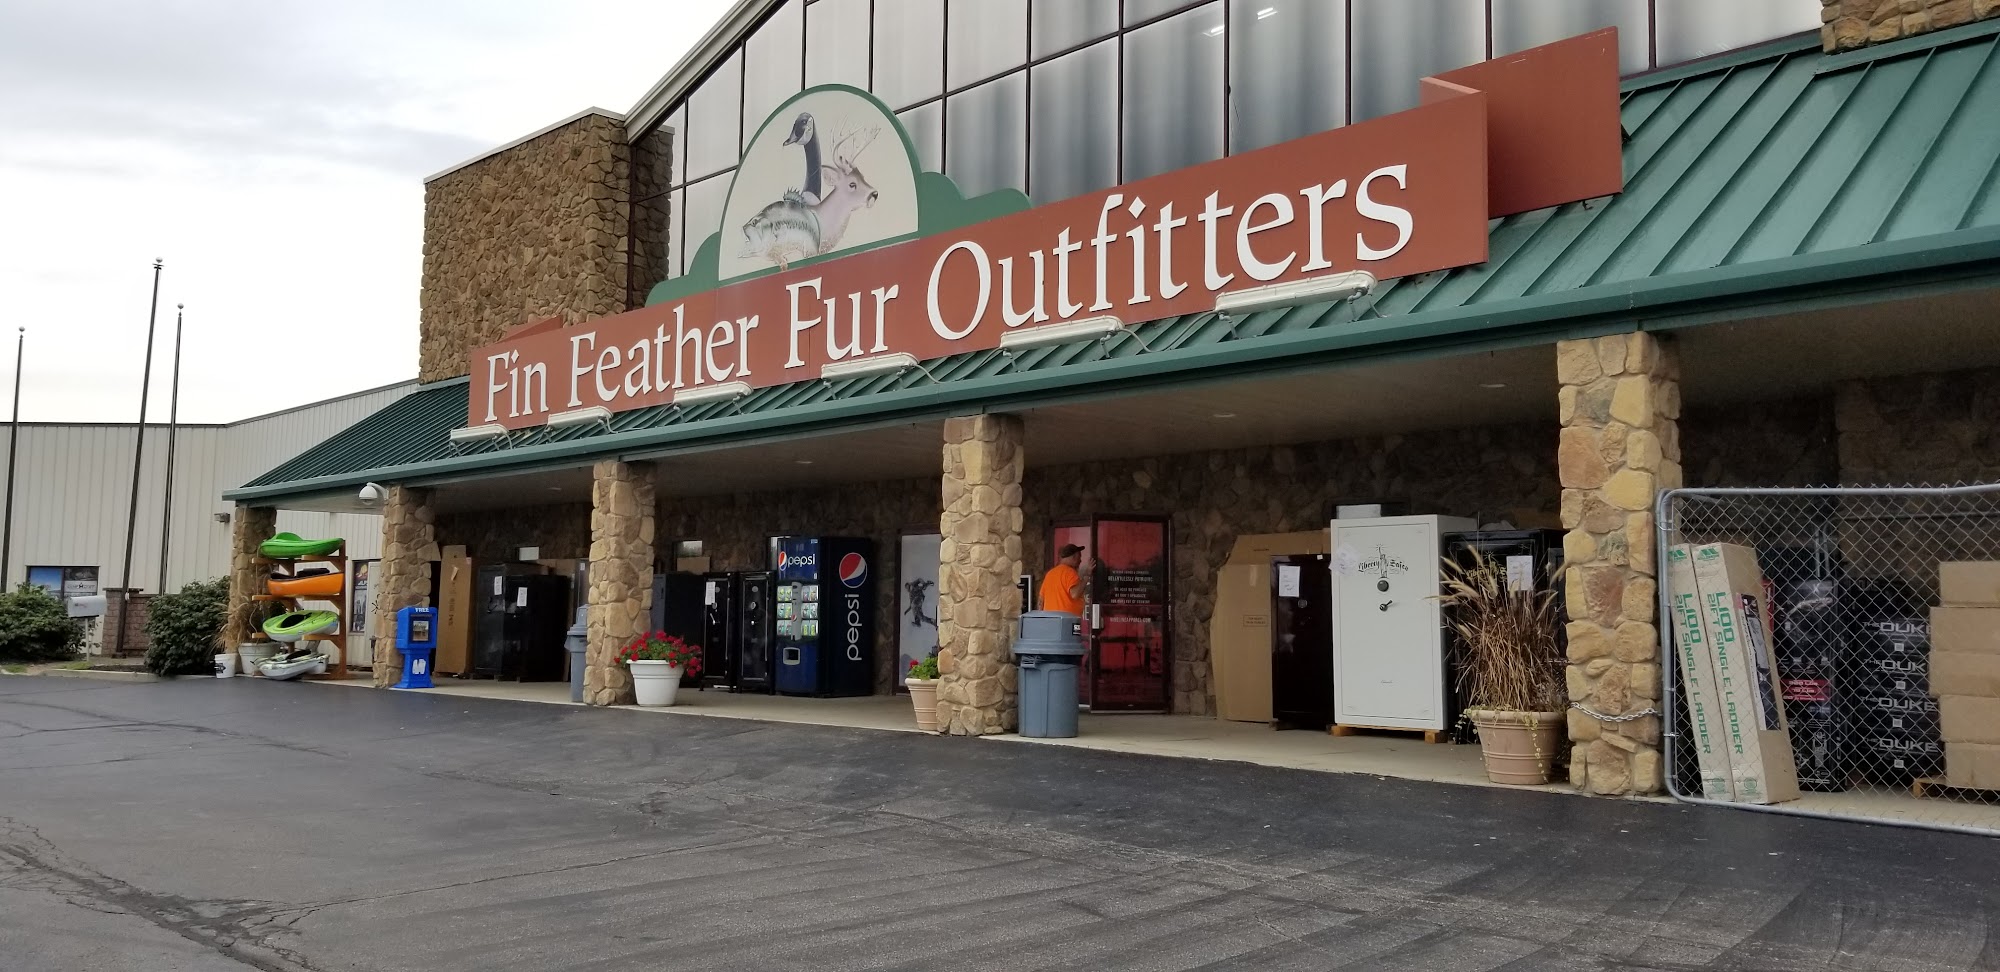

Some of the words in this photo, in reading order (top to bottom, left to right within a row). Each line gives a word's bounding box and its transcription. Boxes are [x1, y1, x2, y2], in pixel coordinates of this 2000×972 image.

[484, 349, 549, 423] Fin
[567, 303, 760, 407] Feather
[784, 276, 901, 369] Fur
[927, 164, 1414, 340] Outfitters
[787, 553, 816, 568] pepsi
[844, 593, 862, 661] pepsi
[1682, 593, 1702, 644] L100
[1715, 591, 1736, 643] L100
[1881, 660, 1927, 672] DUK
[1681, 632, 1699, 687] SINGLE
[1692, 692, 1712, 754] LADDER
[1714, 632, 1732, 687] SINGLE
[1725, 691, 1744, 754] LADDER
[1878, 698, 1938, 711] DUKE
[1879, 738, 1939, 752] DUKE
